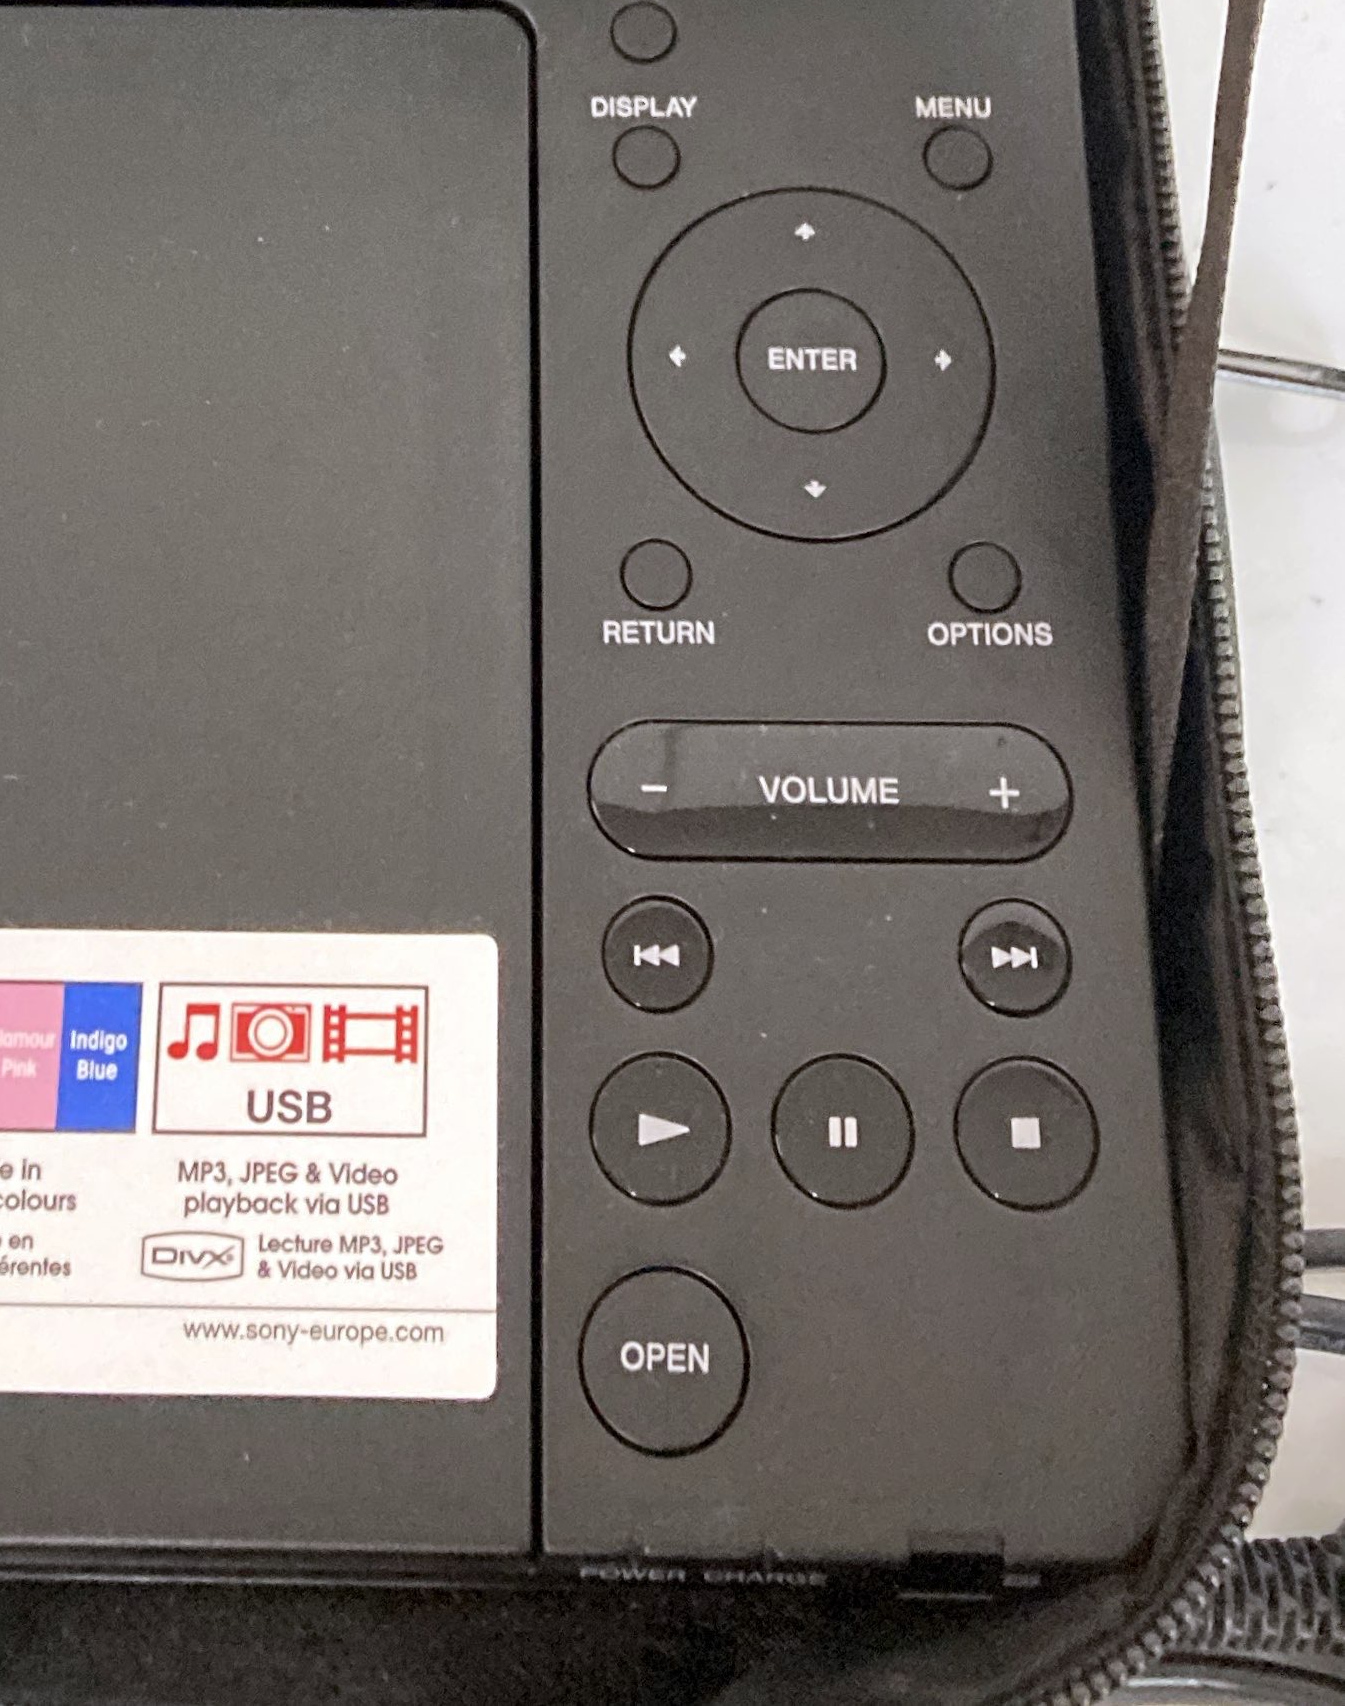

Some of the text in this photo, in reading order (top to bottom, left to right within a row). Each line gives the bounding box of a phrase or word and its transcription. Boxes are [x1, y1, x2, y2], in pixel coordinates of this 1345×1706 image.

[590, 96, 698, 118] DISPLAY
[915, 96, 993, 119] MENU
[767, 348, 858, 372] ENTER
[602, 620, 716, 645] RETURN
[927, 622, 1054, 647] OPTIONS
[758, 775, 900, 806] VOLUME
[70, 1029, 128, 1055] Indigo
[1, 1057, 37, 1078] Pink
[76, 1059, 118, 1081] Blue
[246, 1090, 333, 1125] USB
[21, 1158, 42, 1182] in
[177, 1161, 399, 1188] MP3, JPEG & Video
[183, 1192, 390, 1219] playback via USB
[8, 1234, 34, 1250] en
[258, 1234, 444, 1257] Lecture MP3, JPEG
[257, 1261, 418, 1280] & Video via USB
[183, 1320, 445, 1345] www.sony-europe.com
[620, 1341, 711, 1375] OPEN
